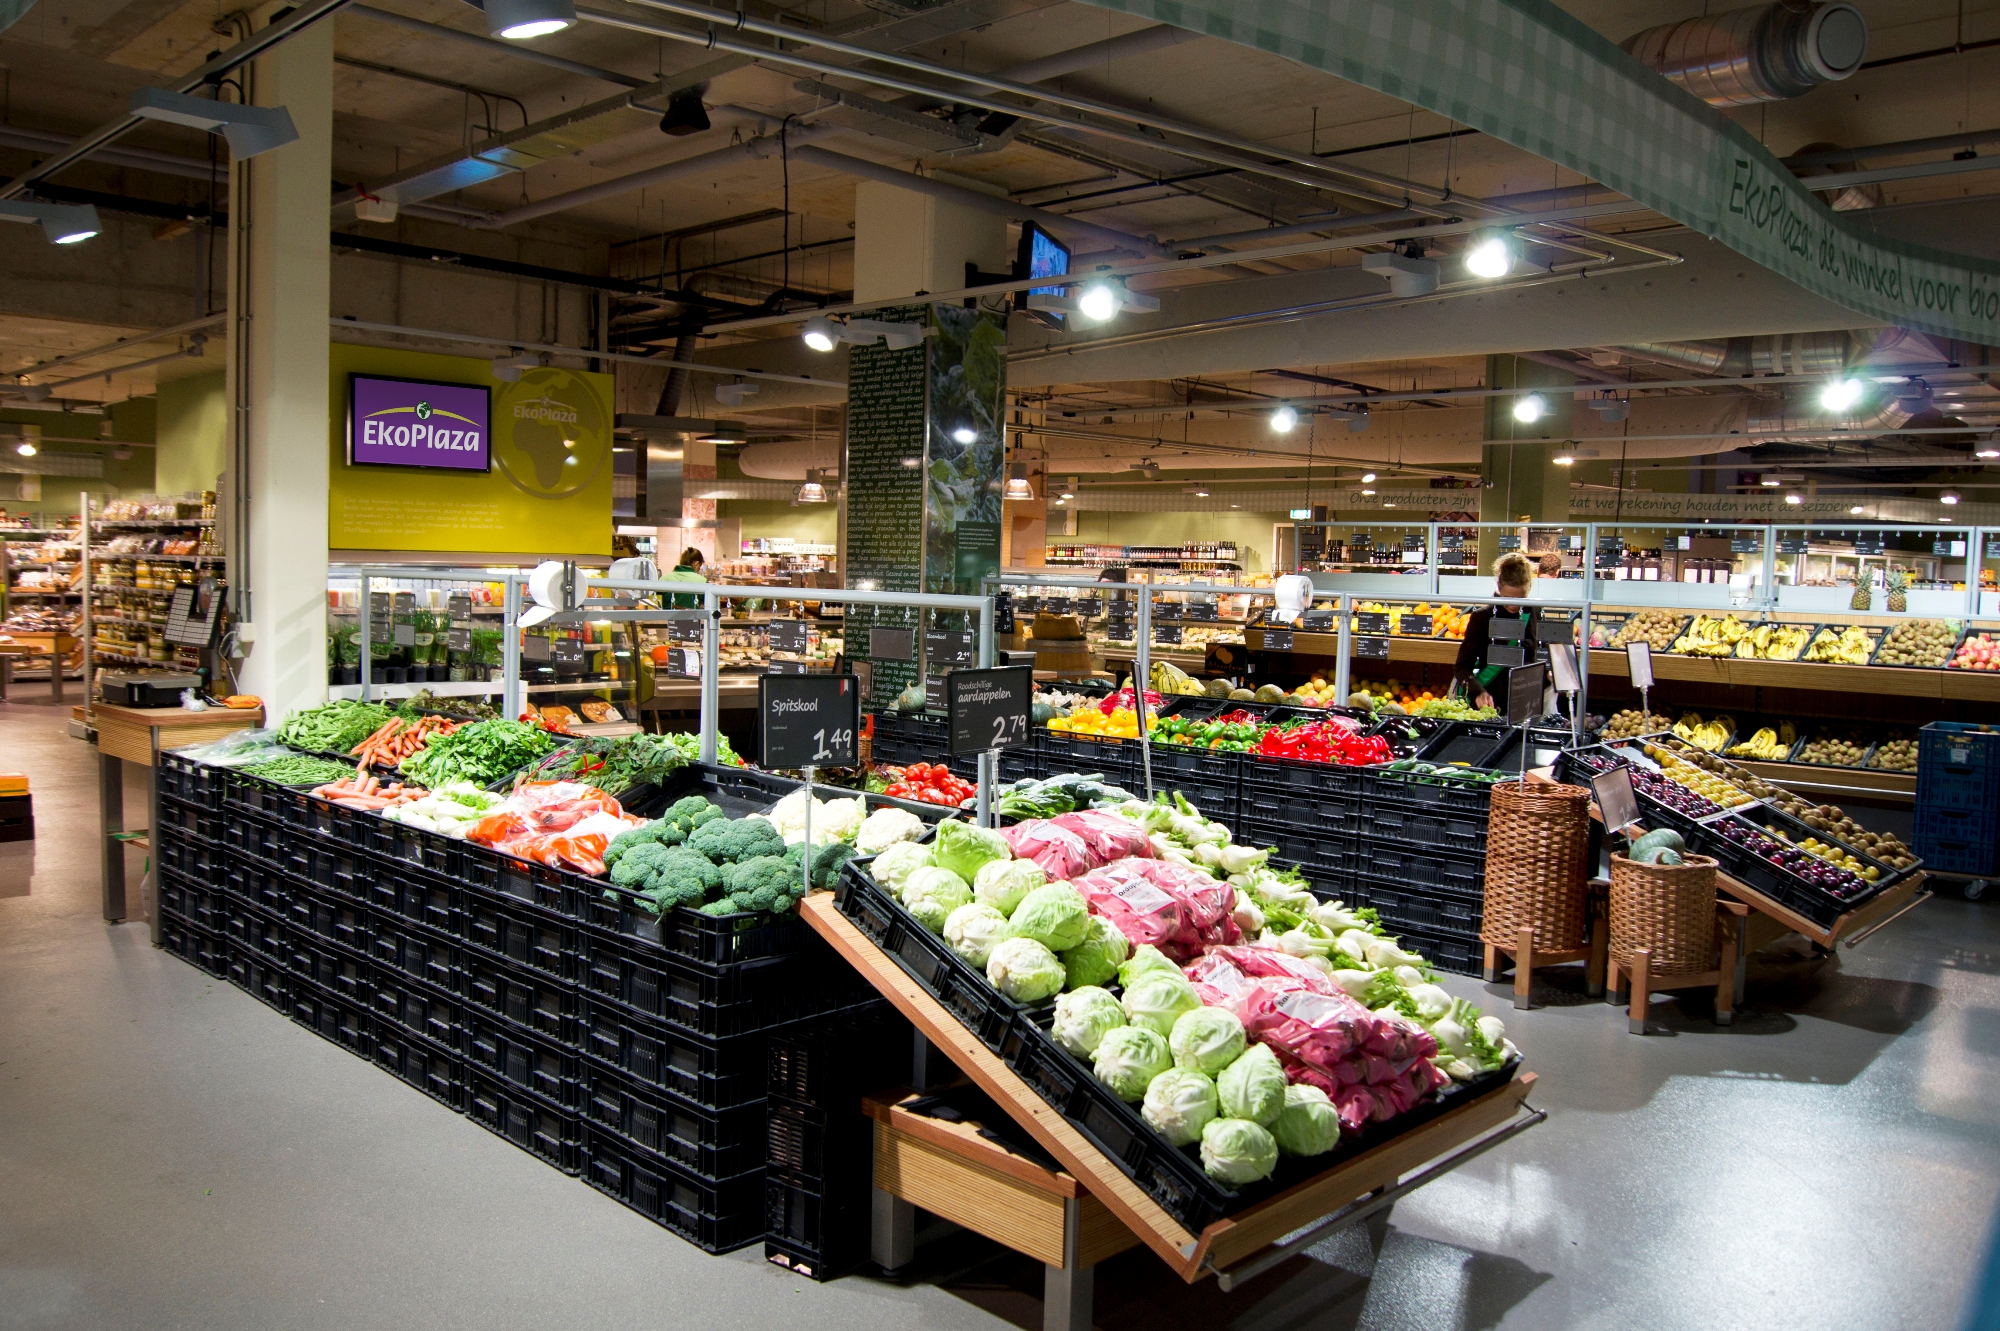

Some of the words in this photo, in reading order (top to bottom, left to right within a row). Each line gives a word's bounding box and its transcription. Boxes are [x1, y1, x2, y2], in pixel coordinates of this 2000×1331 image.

[1842, 242, 1904, 303] winkel
[1910, 276, 1960, 313] voor
[514, 405, 577, 423] EkoPlaza
[364, 420, 480, 452] EkoPlaza
[1350, 492, 1379, 504] Onze
[1382, 492, 1448, 507] producten
[1452, 493, 1477, 509] zijn
[1596, 500, 1615, 509] we
[1620, 497, 1681, 514] rekening
[1686, 497, 1738, 512] houden
[1744, 500, 1773, 511] met
[958, 680, 992, 690] Roodschillige
[958, 687, 1012, 705] aardappelen
[772, 698, 818, 716] Spitskool
[991, 714, 1027, 746] 2.79
[813, 728, 852, 760] 1.49
